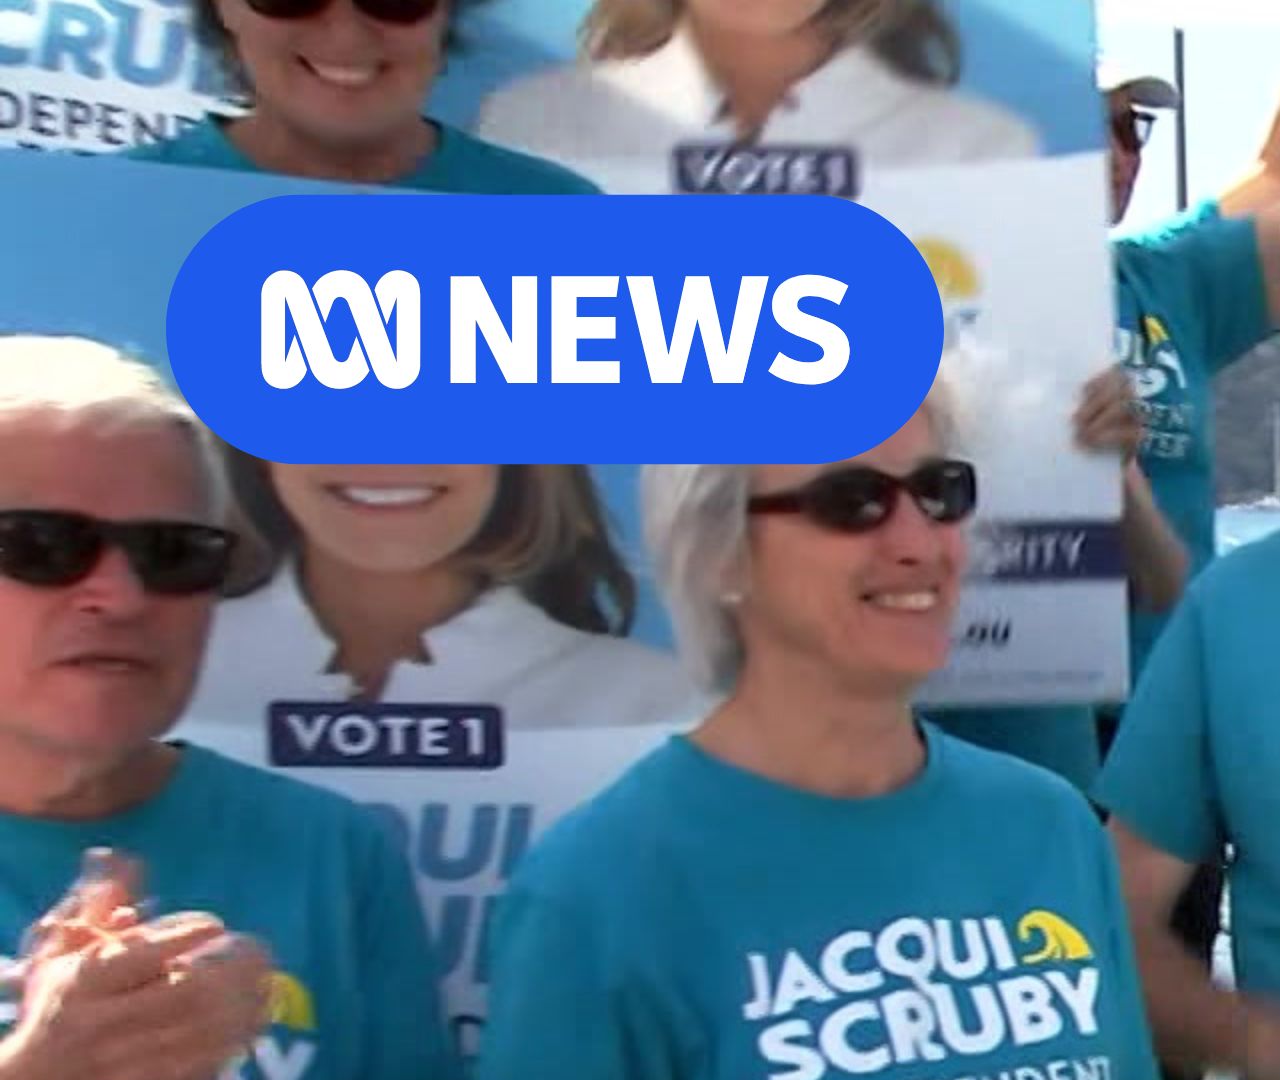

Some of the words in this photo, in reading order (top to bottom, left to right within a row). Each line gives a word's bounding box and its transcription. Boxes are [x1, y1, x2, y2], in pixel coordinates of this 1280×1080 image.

[0, 88, 203, 145] DEPEN
[286, 712, 453, 756] VOTE
[461, 716, 486, 757] 1
[742, 916, 1018, 1021] JACQUI
